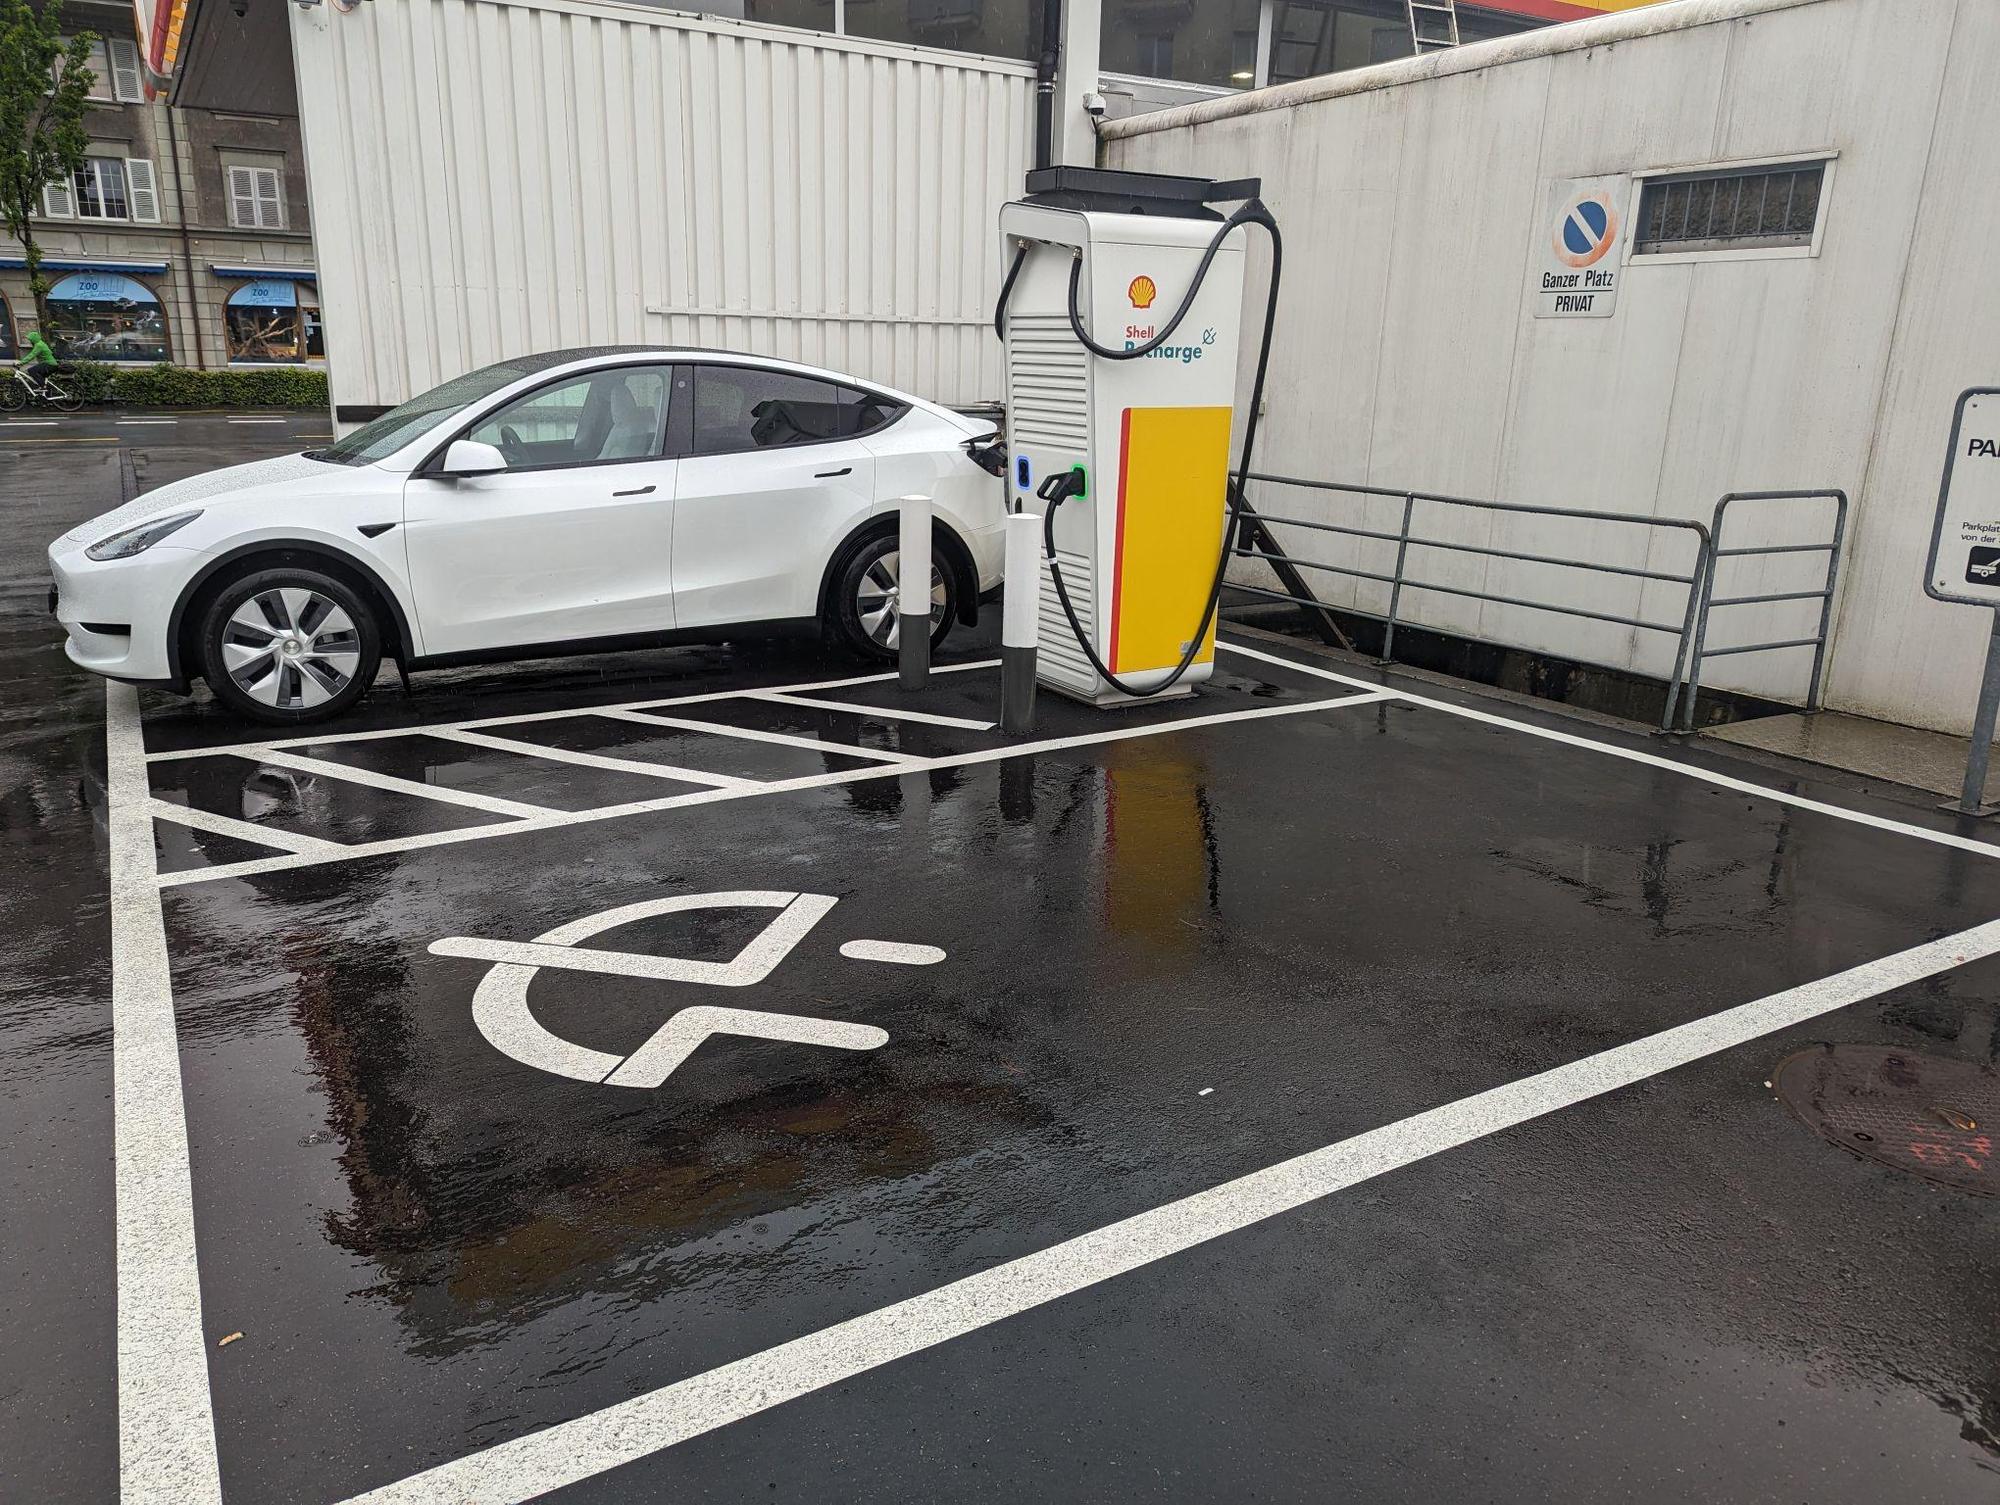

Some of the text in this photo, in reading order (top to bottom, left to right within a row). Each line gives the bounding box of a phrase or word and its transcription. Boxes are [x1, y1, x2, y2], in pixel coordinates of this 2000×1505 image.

[1542, 270, 1614, 288] Ganzer Platz
[1554, 295, 1595, 312] PRIVAT
[1125, 325, 1155, 339] Shell
[1124, 340, 1203, 363] Rharge
[1967, 438, 2000, 458] PA
[1961, 534, 1978, 542] von
[1980, 535, 1997, 543] der
